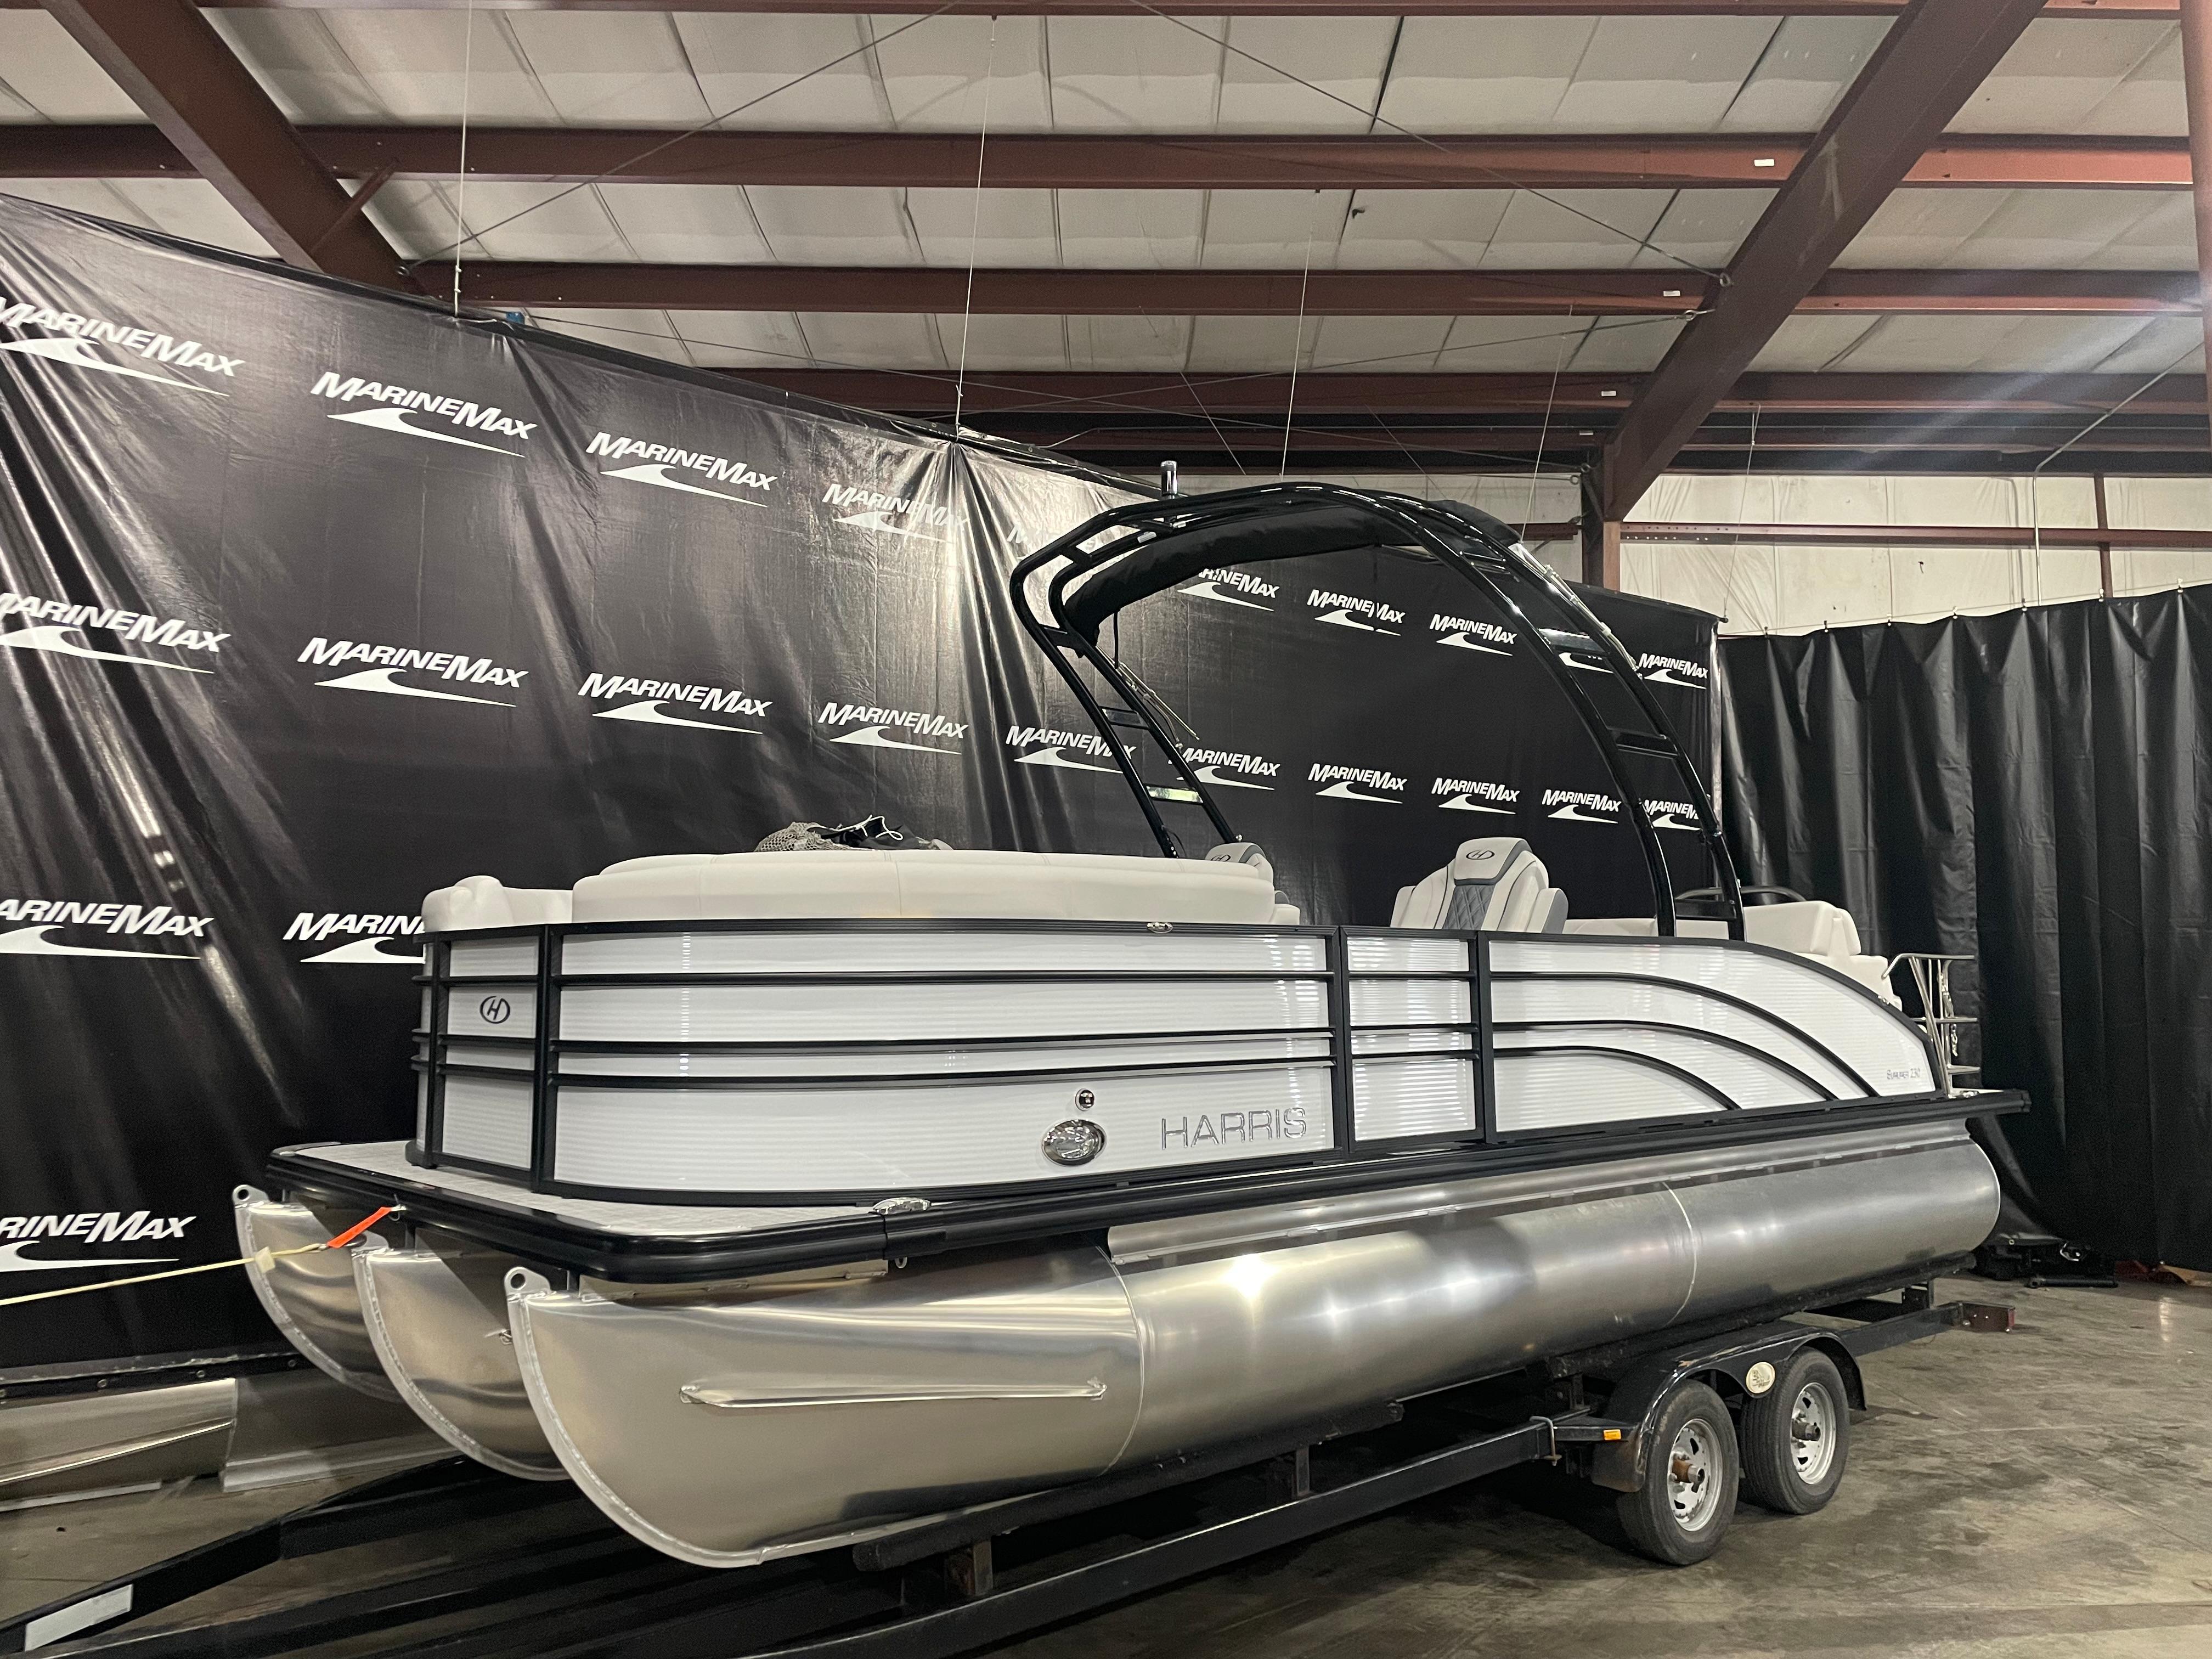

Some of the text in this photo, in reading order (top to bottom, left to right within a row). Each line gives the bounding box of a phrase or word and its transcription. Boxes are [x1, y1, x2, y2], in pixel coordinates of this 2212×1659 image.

[311, 371, 538, 439] MARINEMAX
[585, 432, 778, 490] MARINEMAX
[1307, 589, 1406, 623] MARINEMAX
[1429, 614, 1517, 645] MARINEMAX
[297, 637, 529, 688] MARINEMAX
[1639, 653, 1708, 679] MARINEMAX
[578, 673, 772, 717] MARINEMAX
[818, 702, 968, 739] MARINEMAX
[1005, 725, 1137, 760] MARINEMX
[1308, 763, 1407, 791] MARINEMAX
[1431, 777, 1520, 802] MARINEMAX
[1542, 789, 1621, 812] MARINEMAX
[1161, 1107, 1307, 1150] HARRIS
